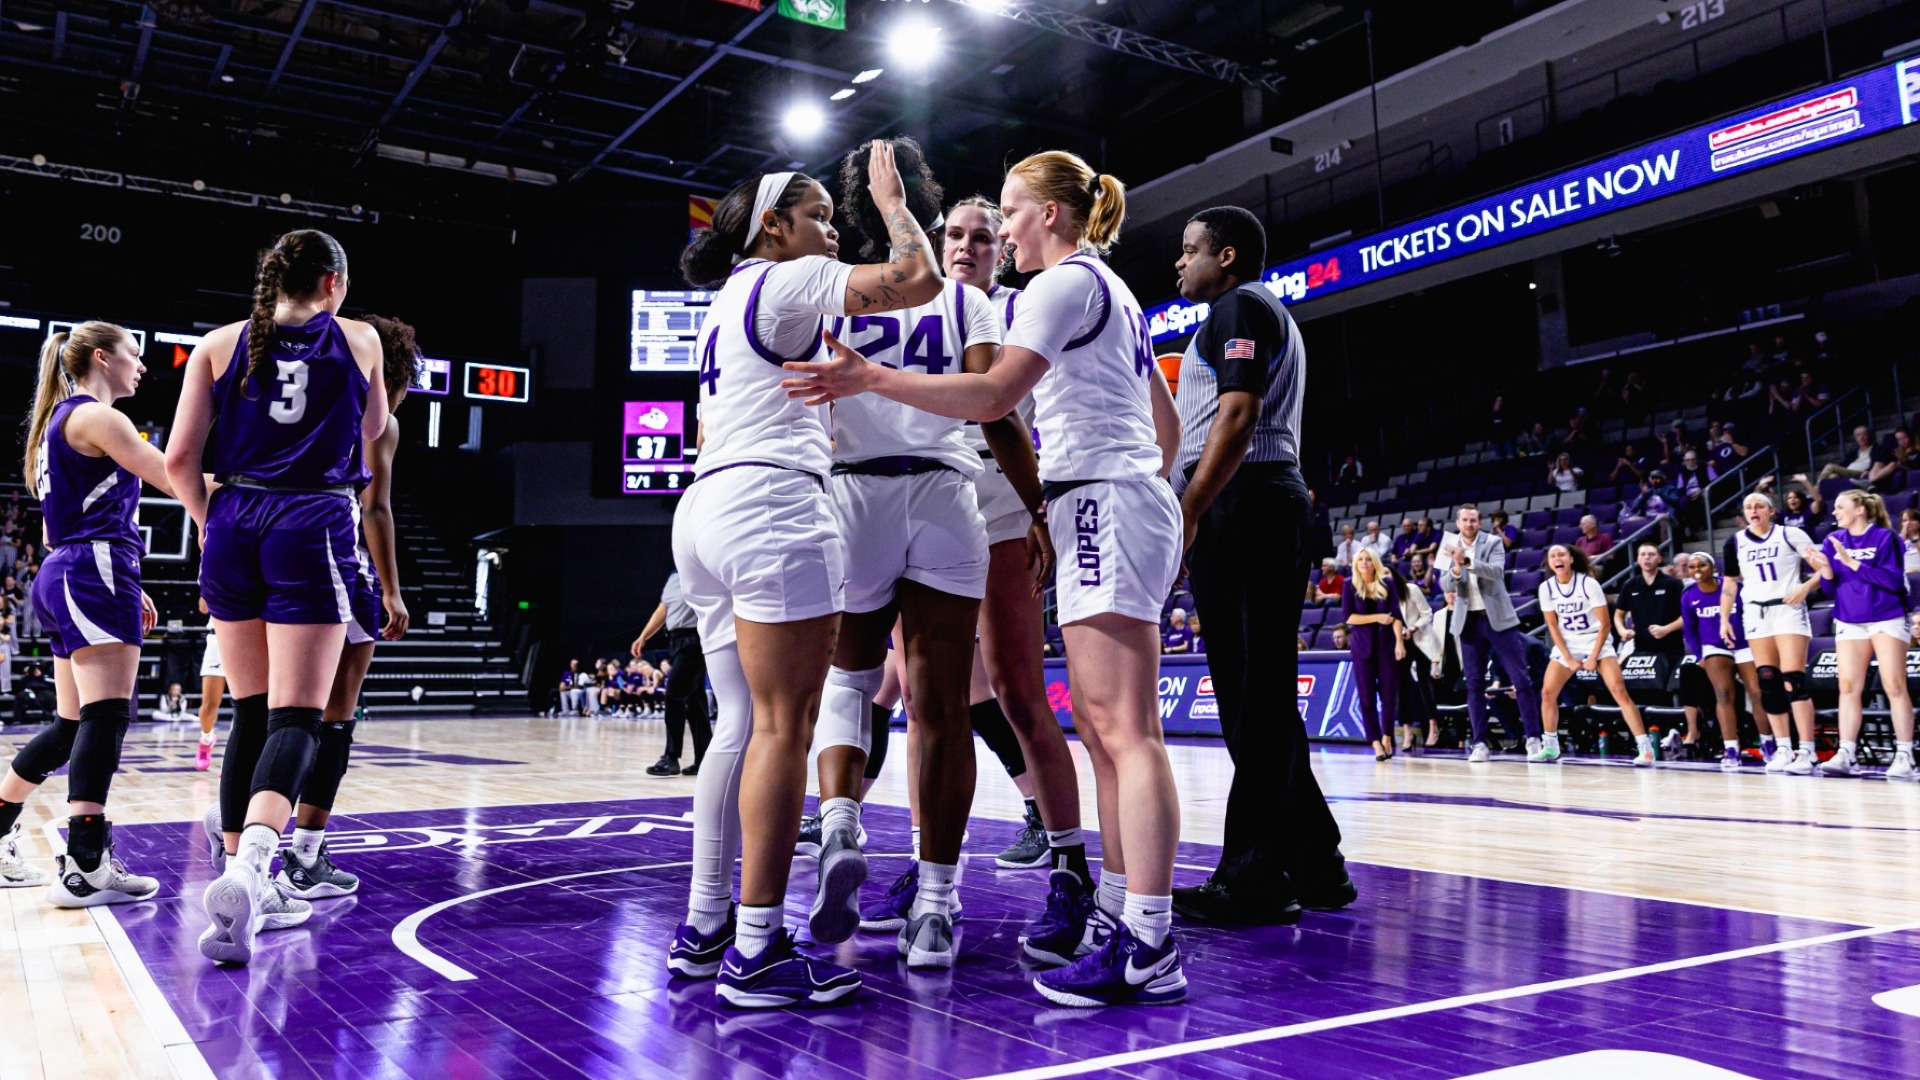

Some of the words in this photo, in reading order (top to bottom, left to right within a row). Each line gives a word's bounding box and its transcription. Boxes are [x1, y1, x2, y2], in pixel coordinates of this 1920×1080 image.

[1681, 0, 1725, 30] 213
[1315, 147, 1341, 173] 214
[1360, 222, 1451, 273] TICKETS
[1456, 205, 1505, 243] ON
[1510, 181, 1582, 228] SALE
[1587, 149, 1681, 205] NOW
[80, 223, 122, 244] 200
[849, 314, 953, 375] 24
[268, 359, 310, 425] 3
[478, 367, 517, 398] 30
[636, 436, 667, 460] 37
[1074, 498, 1102, 588] LOPES
[1746, 546, 1779, 563] GCU
[1756, 562, 1778, 582] 11
[1556, 601, 1584, 614] GCU
[1563, 613, 1590, 631] 23
[1621, 668, 1657, 676] GLOBAL
[1625, 655, 1657, 669] GCU
